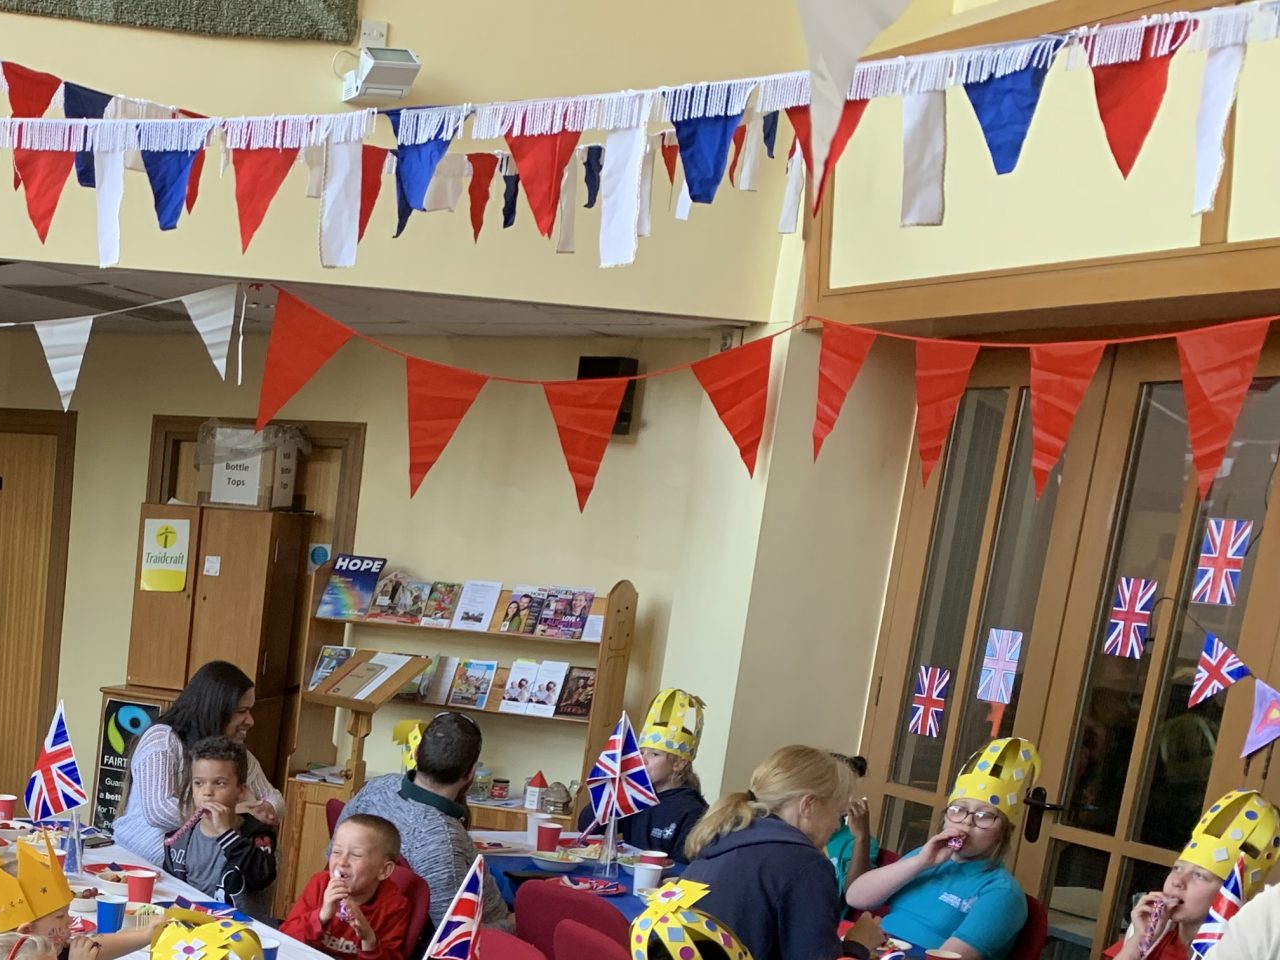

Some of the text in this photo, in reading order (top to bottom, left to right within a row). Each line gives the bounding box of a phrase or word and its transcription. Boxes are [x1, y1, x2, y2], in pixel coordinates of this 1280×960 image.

[225, 462, 249, 472] Bottle
[227, 477, 246, 487] Tops
[145, 551, 185, 565] Traidcraft
[334, 557, 383, 573] HOPE
[97, 804, 108, 813] for
